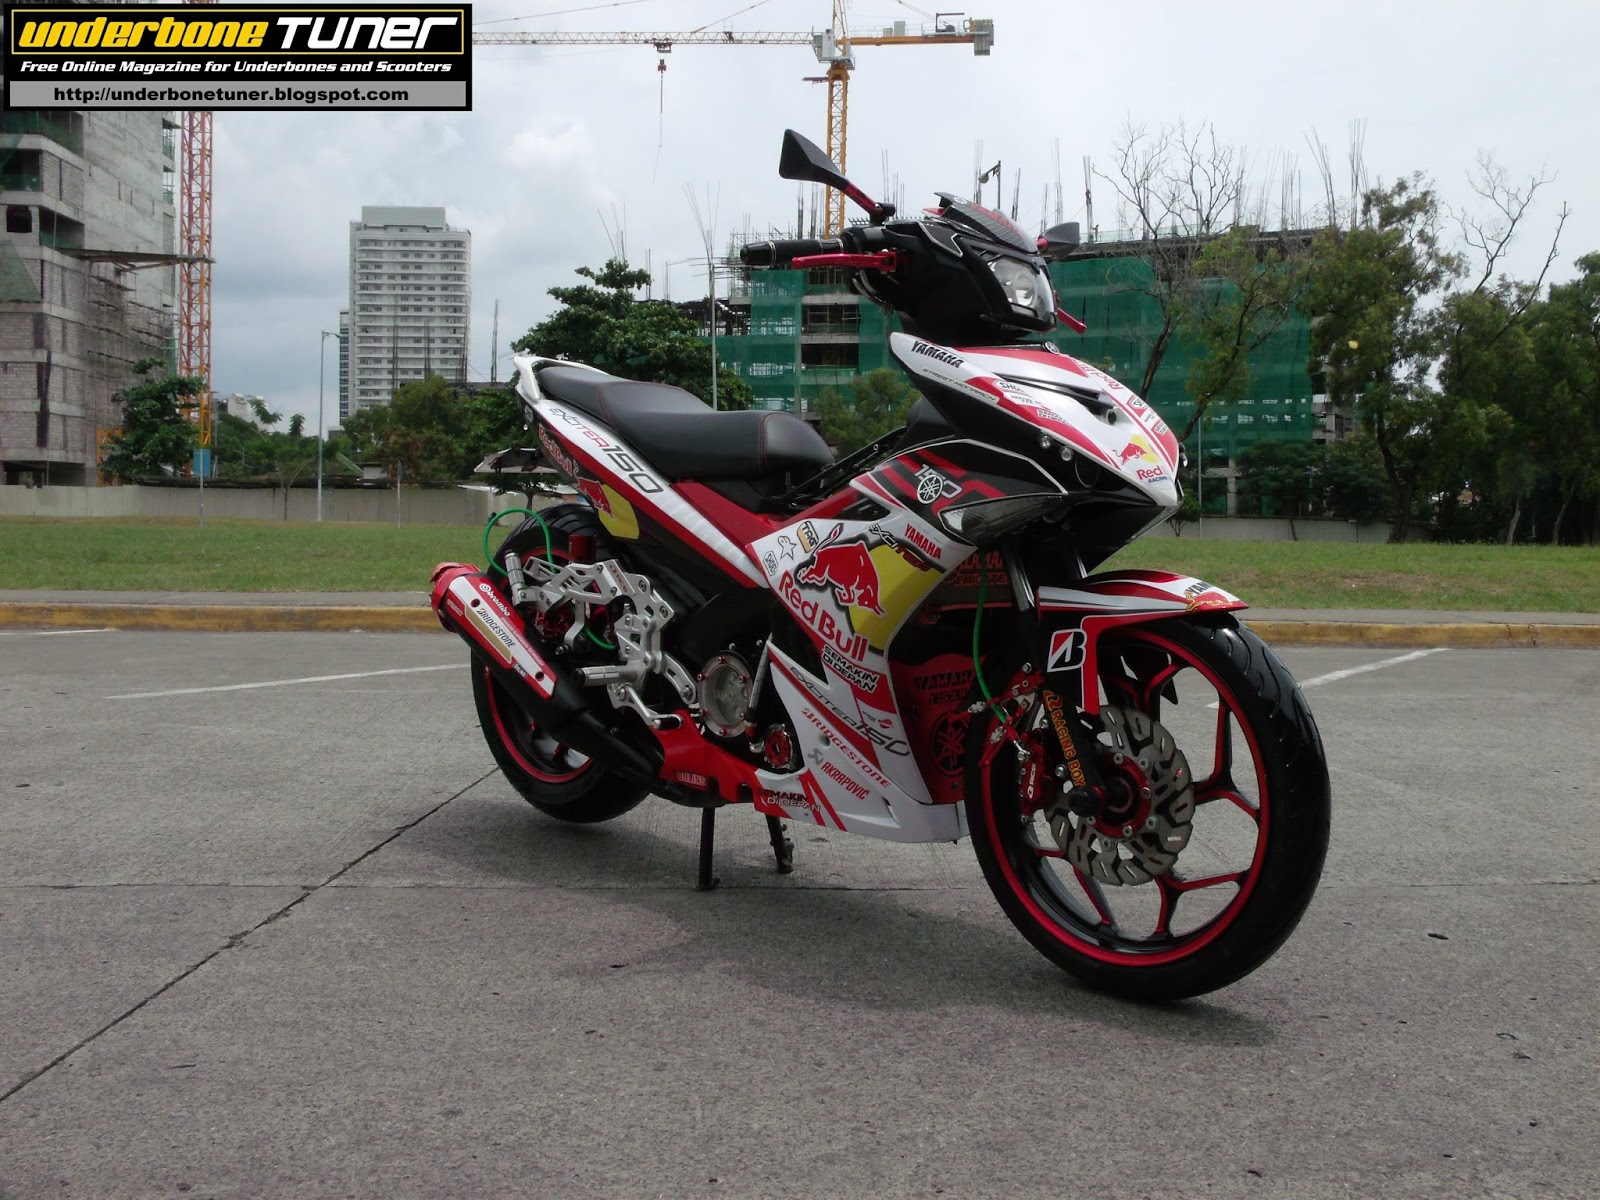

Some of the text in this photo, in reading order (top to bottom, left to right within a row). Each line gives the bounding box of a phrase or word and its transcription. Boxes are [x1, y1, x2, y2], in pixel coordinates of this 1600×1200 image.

[911, 340, 964, 369] YAMAHA
[1136, 465, 1163, 480] Red
[802, 520, 818, 547] TAG
[904, 523, 942, 560] YAMAHA
[486, 588, 511, 617] brembo
[778, 570, 869, 662] Red Bull
[476, 607, 516, 649] BRIDGESTONE
[822, 653, 877, 692] DI DEPAN
[824, 645, 879, 683] SEMAKIN
[801, 707, 893, 789] BRIDGESTONE
[1050, 709, 1087, 787] RACING BOY
